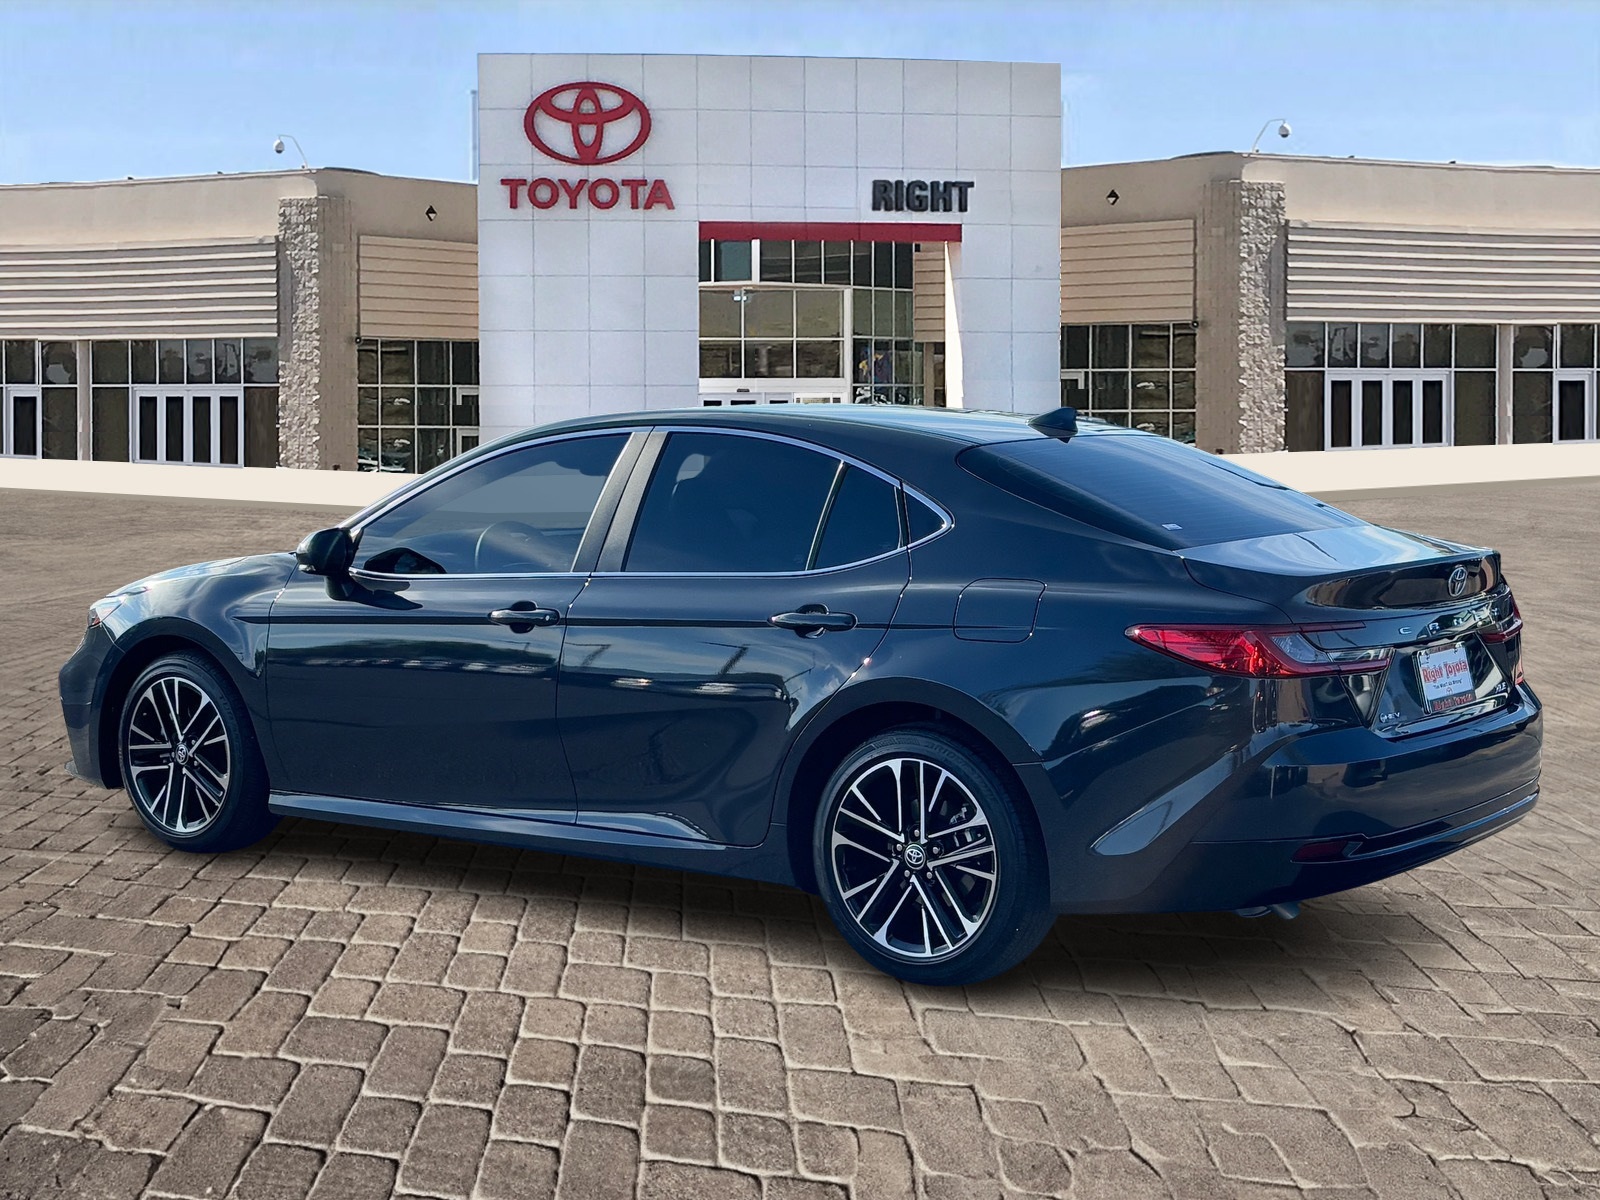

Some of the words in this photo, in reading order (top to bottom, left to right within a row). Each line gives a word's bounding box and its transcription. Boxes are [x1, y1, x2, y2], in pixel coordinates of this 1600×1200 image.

[500, 178, 675, 210] TOYOTA
[872, 179, 975, 212] RIGHT
[1421, 664, 1444, 683] Right
[1443, 660, 1468, 678] Toyota
